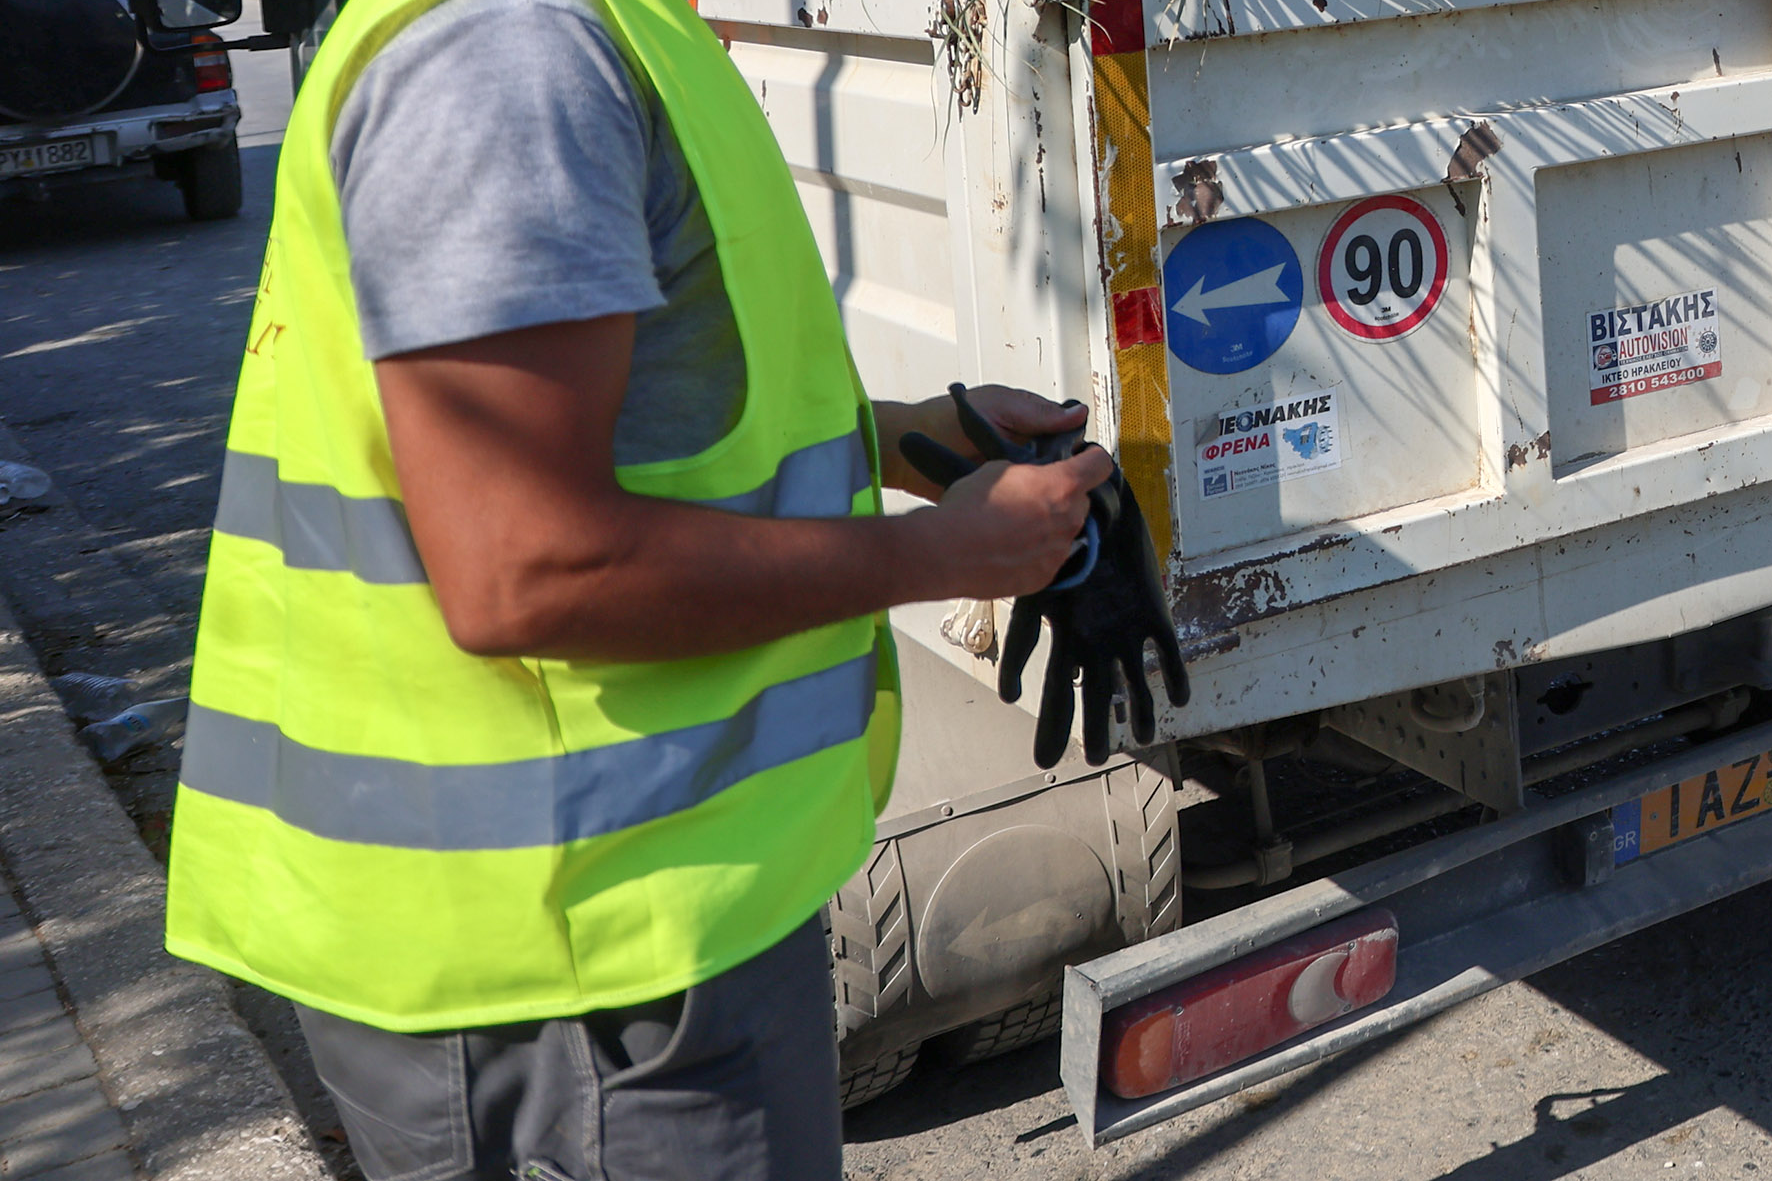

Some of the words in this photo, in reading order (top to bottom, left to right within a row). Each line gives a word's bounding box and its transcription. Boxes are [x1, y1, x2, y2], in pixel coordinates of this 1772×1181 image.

[1344, 228, 1424, 306] 90
[1590, 290, 1715, 342] ΒΙΣΤΑΚΗΣ
[1619, 325, 1688, 359] AUTOVISION
[1602, 369, 1629, 384] ΙΚΤΕΟ
[1631, 357, 1682, 377] ΗΡΑΚΛΕΙΟΥ
[1609, 380, 1646, 398] 2810
[1651, 366, 1705, 388] 543400
[1203, 433, 1270, 461] ΦΡΕΝΑ
[1614, 829, 1636, 852] GR
